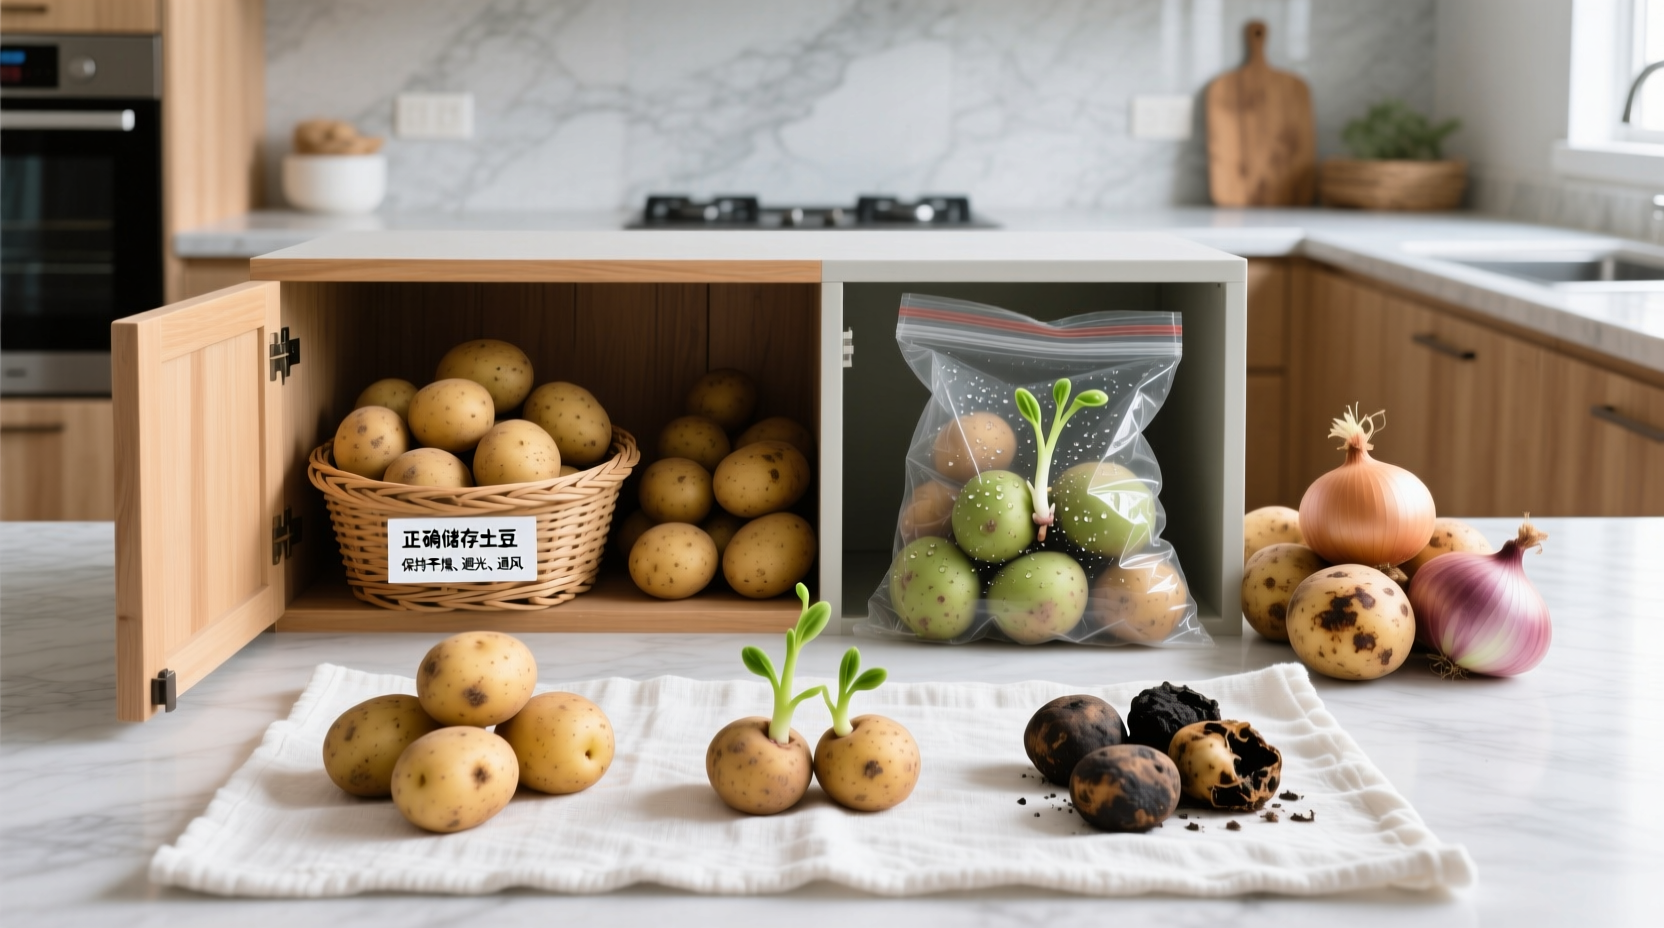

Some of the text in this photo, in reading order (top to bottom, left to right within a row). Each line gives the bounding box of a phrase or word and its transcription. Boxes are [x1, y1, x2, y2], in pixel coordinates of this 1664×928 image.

[402, 528, 517, 548] 正确储存土豆
